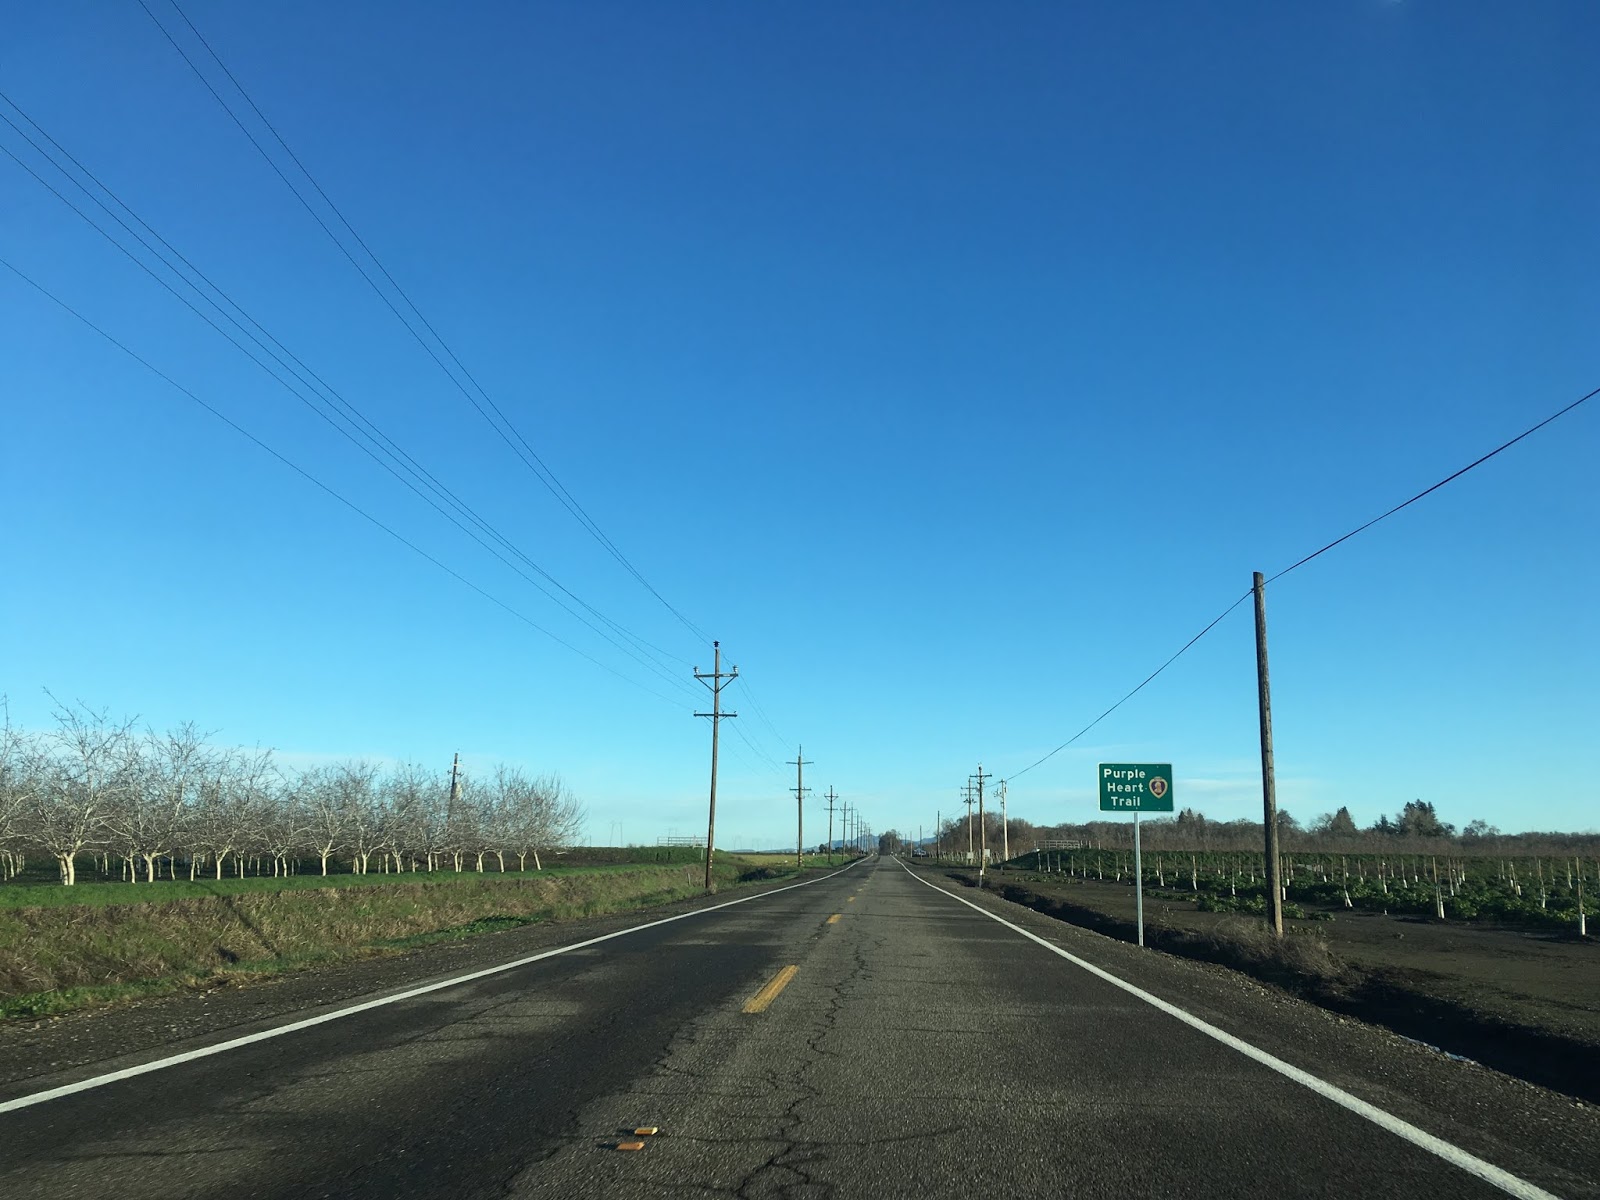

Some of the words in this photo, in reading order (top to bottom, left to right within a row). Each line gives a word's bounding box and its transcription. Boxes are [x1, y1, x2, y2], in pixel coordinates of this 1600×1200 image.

[1103, 768, 1146, 781] Purple
[1107, 782, 1144, 792] Heart
[1110, 795, 1140, 806] Trail
